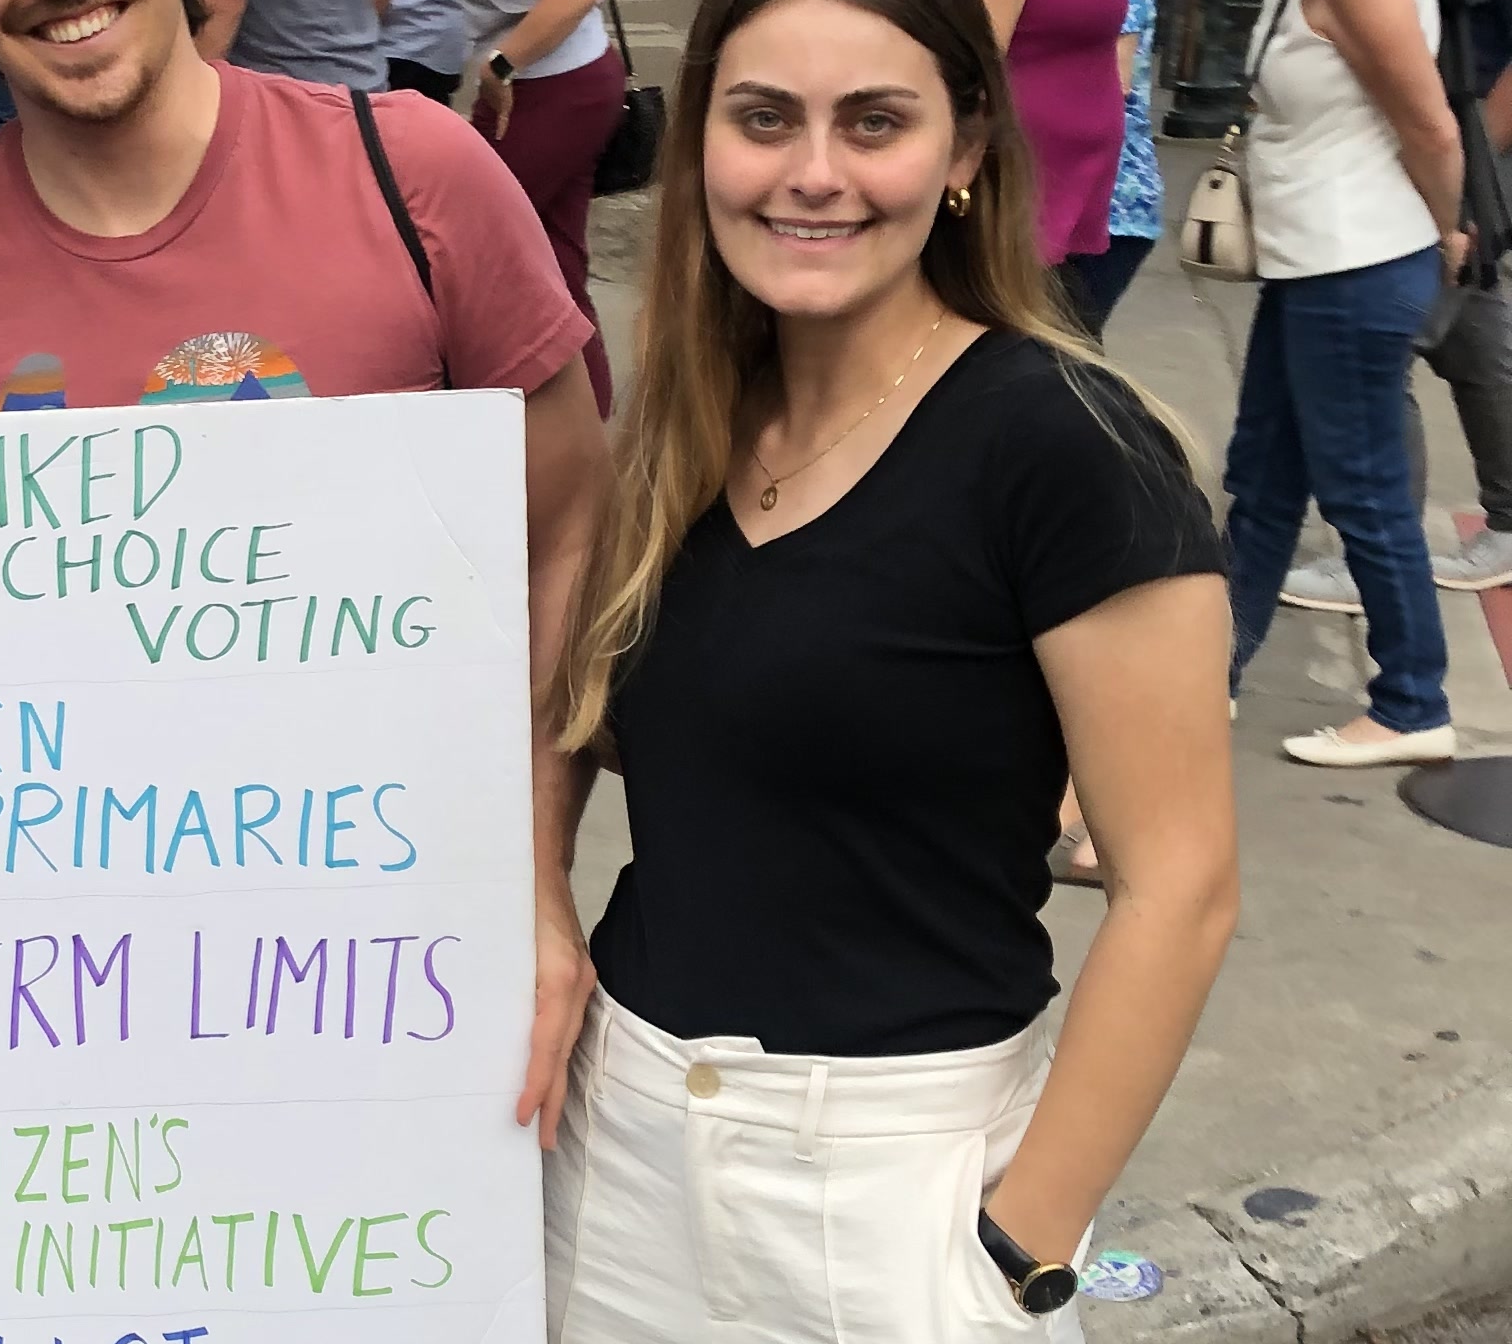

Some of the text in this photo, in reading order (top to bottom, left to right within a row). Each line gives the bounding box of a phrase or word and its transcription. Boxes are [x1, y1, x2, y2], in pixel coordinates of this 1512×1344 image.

[1, 522, 293, 601] CHOICE
[126, 595, 438, 664] VOTING
[189, 931, 463, 1045] LIMITS
[15, 1210, 453, 1298] INITIATIVES
